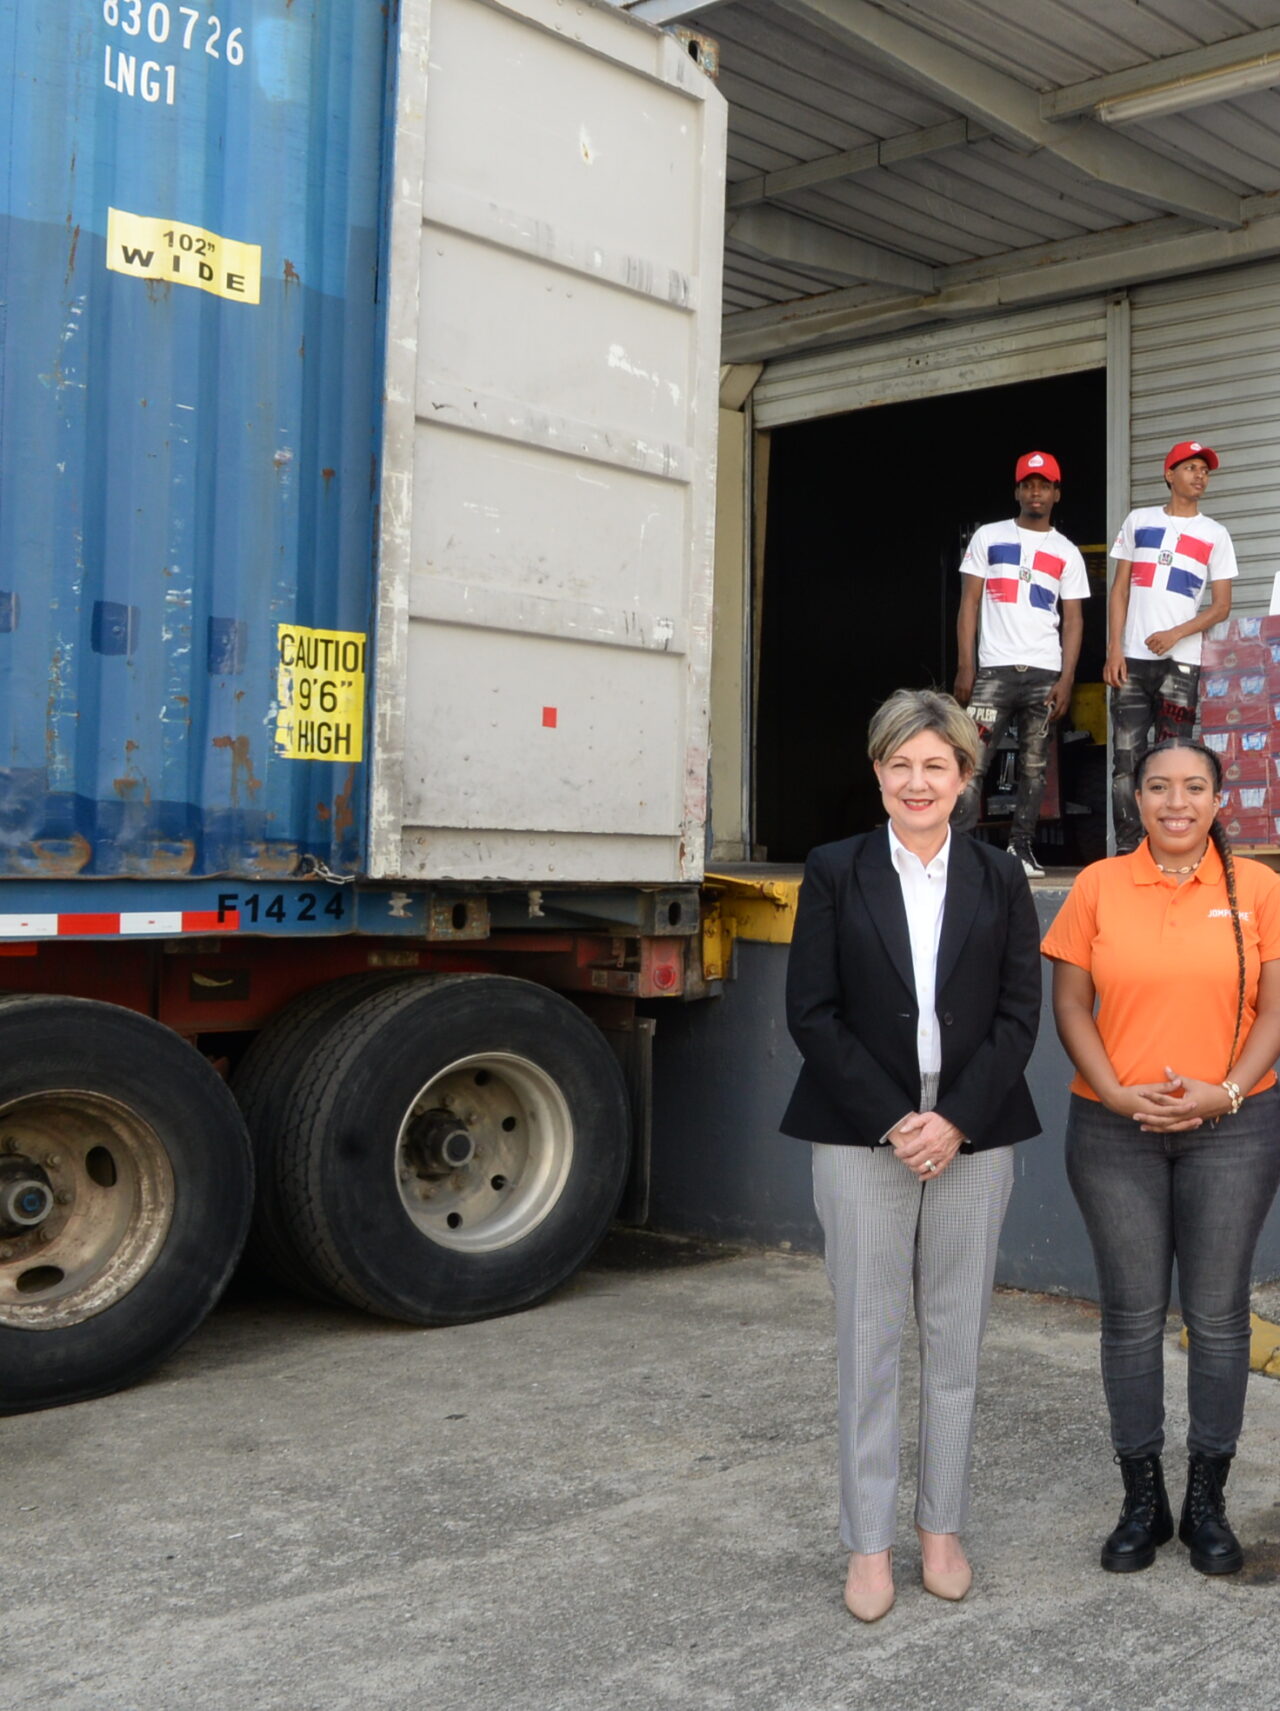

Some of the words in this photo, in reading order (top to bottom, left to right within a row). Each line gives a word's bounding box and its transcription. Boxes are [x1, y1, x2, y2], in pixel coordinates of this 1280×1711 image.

[104, 44, 175, 105] LNG1
[281, 633, 366, 673] CAUTIO
[298, 720, 352, 755] HIGH
